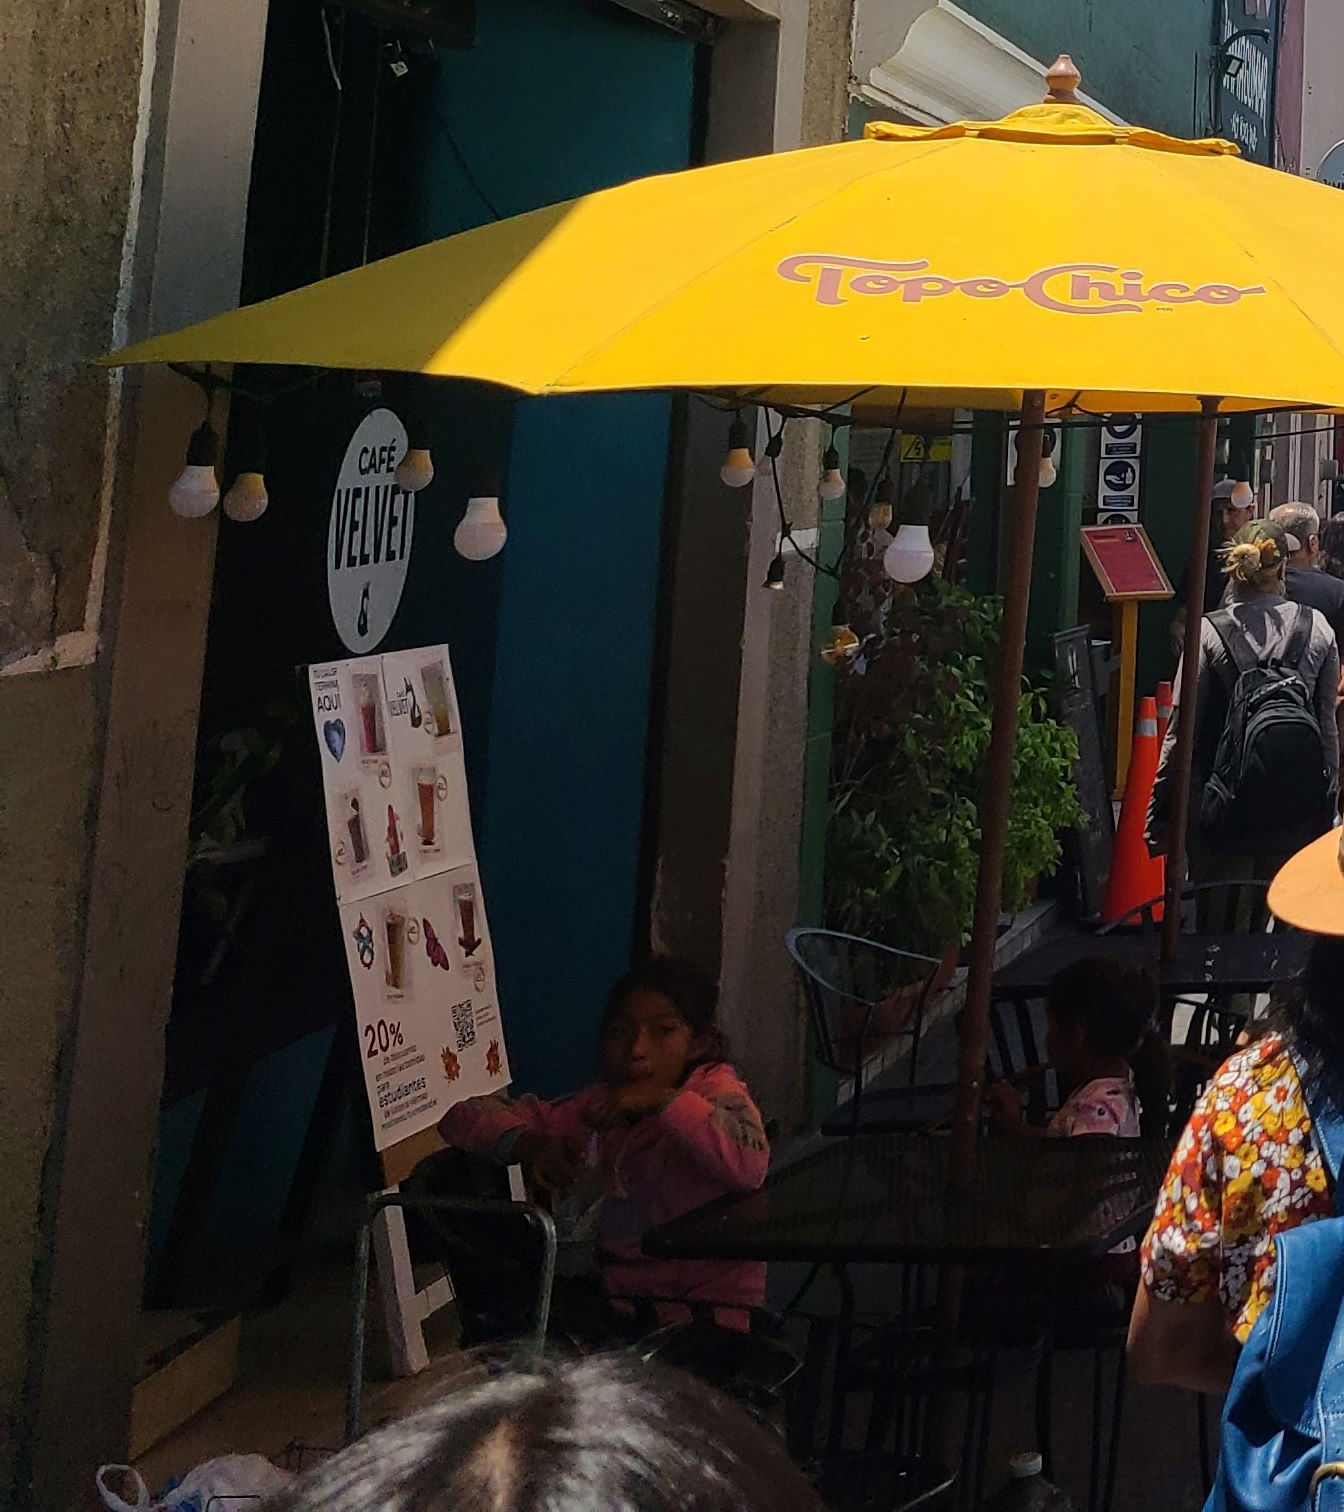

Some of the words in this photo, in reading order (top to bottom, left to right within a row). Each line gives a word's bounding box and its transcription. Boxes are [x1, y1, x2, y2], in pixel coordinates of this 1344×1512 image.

[776, 253, 1011, 305] Topo
[1022, 263, 1267, 315] Chico
[358, 438, 397, 476] CAFÉ
[334, 483, 414, 570] VELVET
[364, 1018, 404, 1059] 20%
